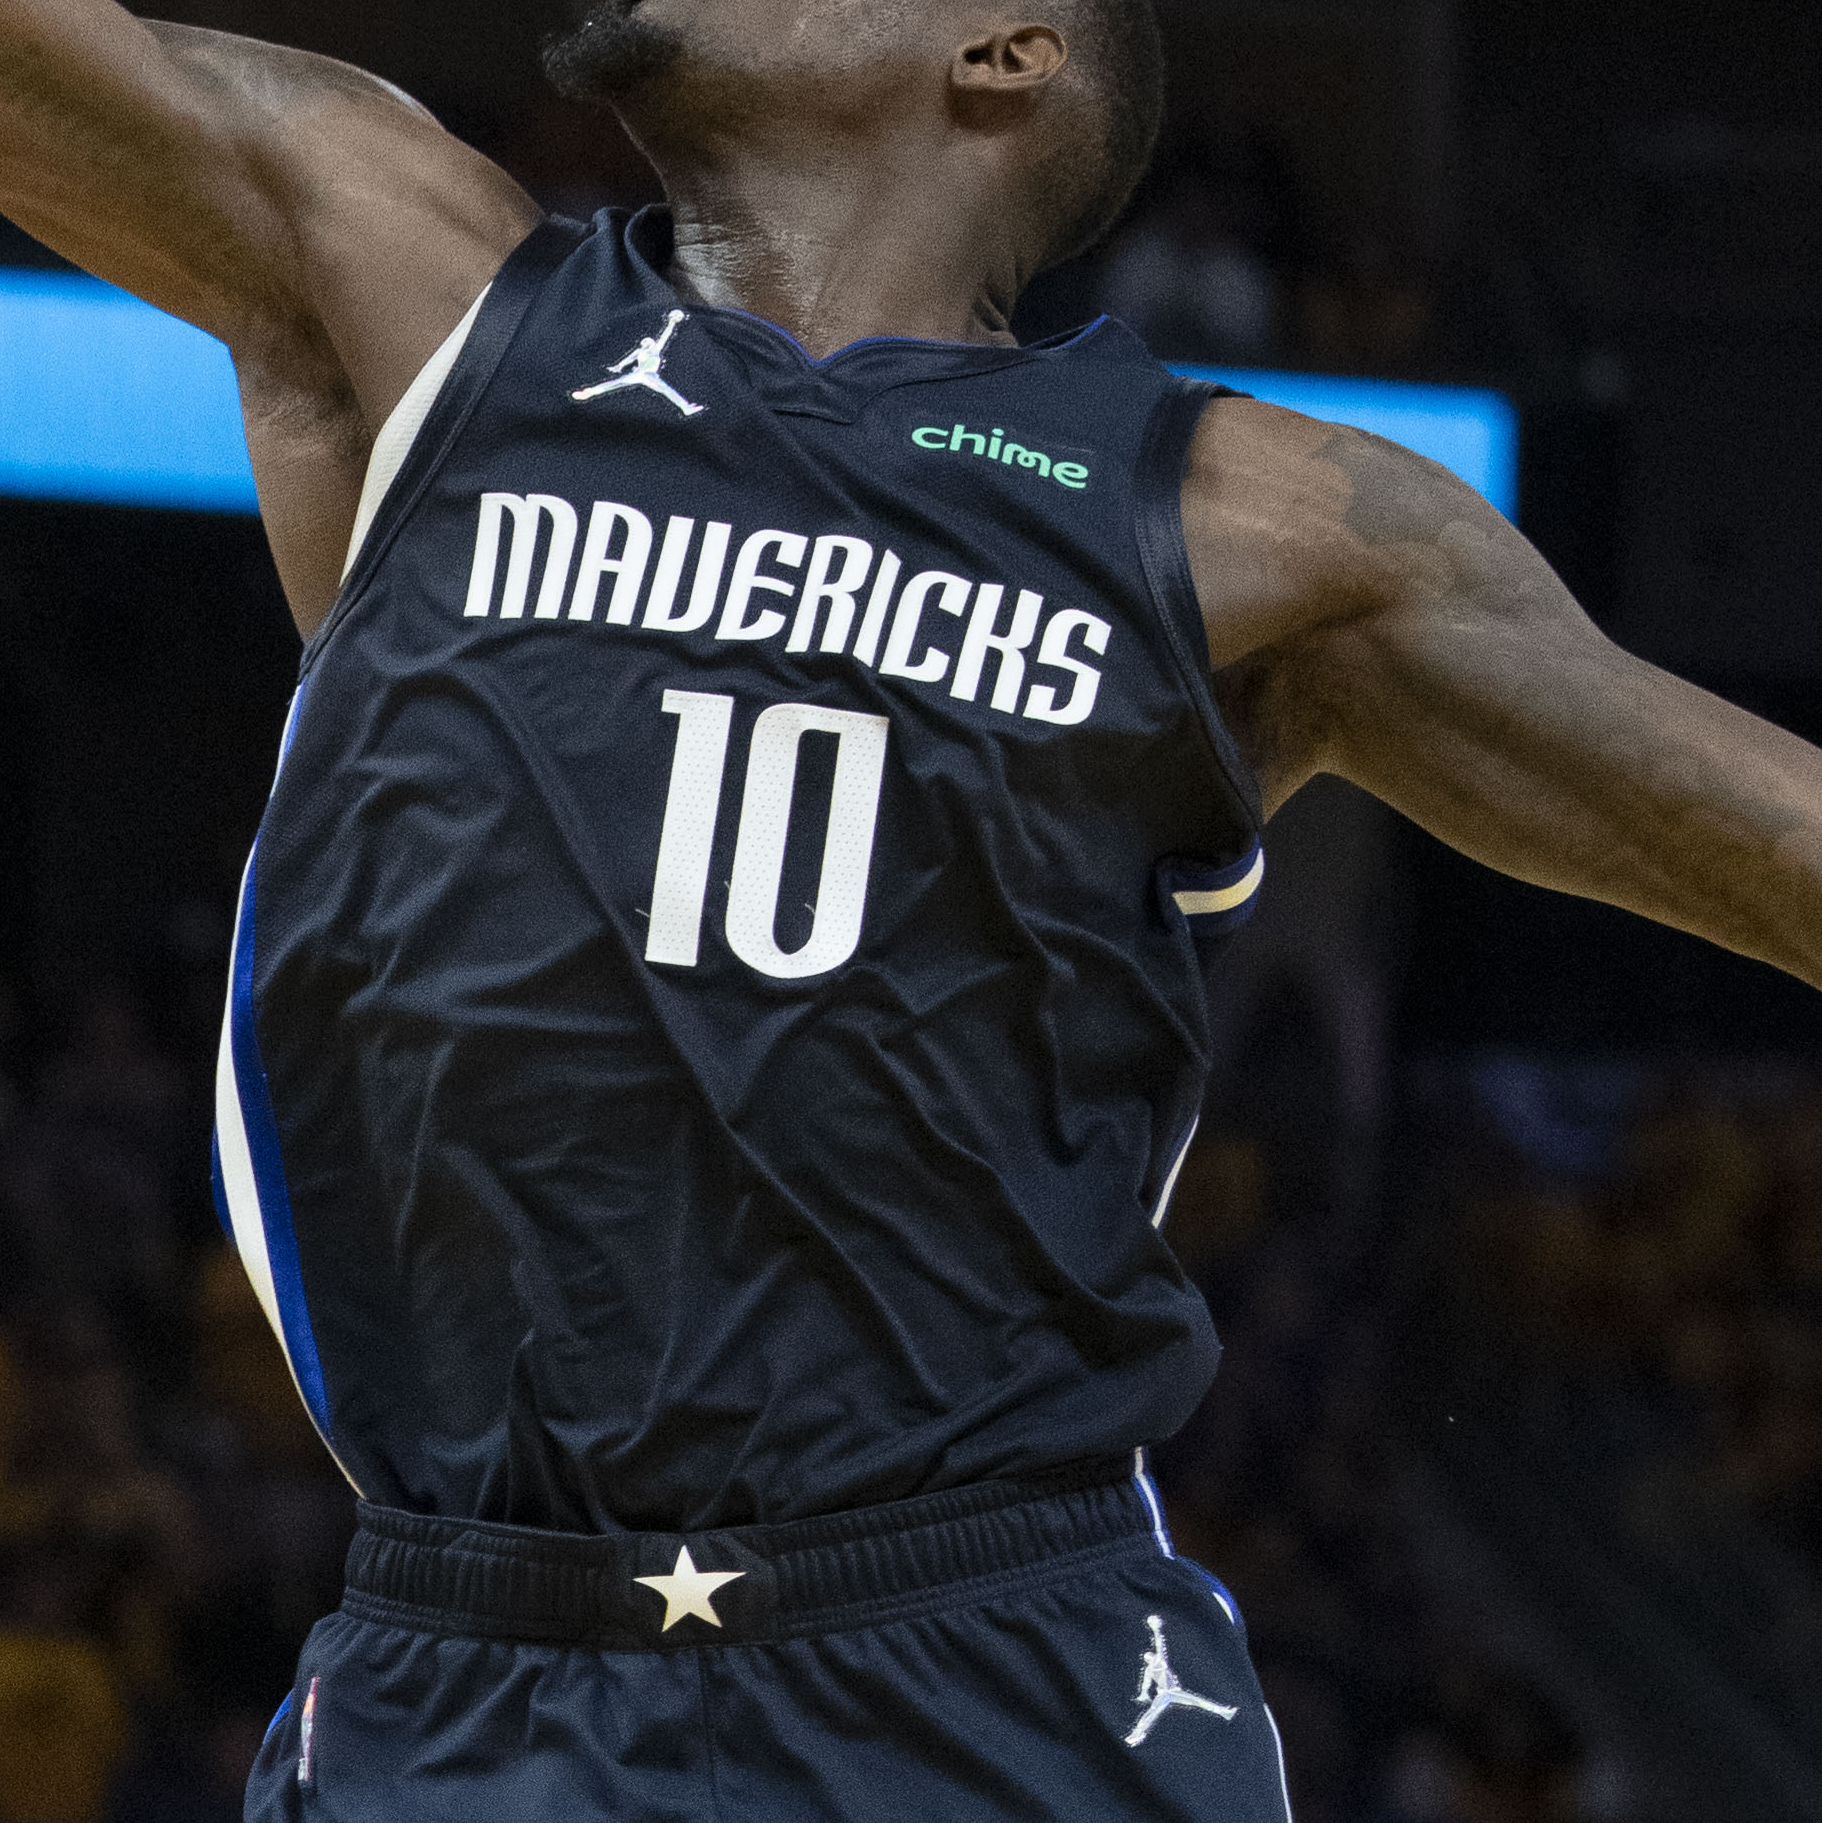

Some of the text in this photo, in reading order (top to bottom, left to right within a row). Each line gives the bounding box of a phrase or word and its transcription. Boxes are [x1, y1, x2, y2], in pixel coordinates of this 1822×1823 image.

[910, 423, 1091, 490] chime
[463, 492, 1113, 727] MAVERICKS
[644, 688, 890, 980] 10
